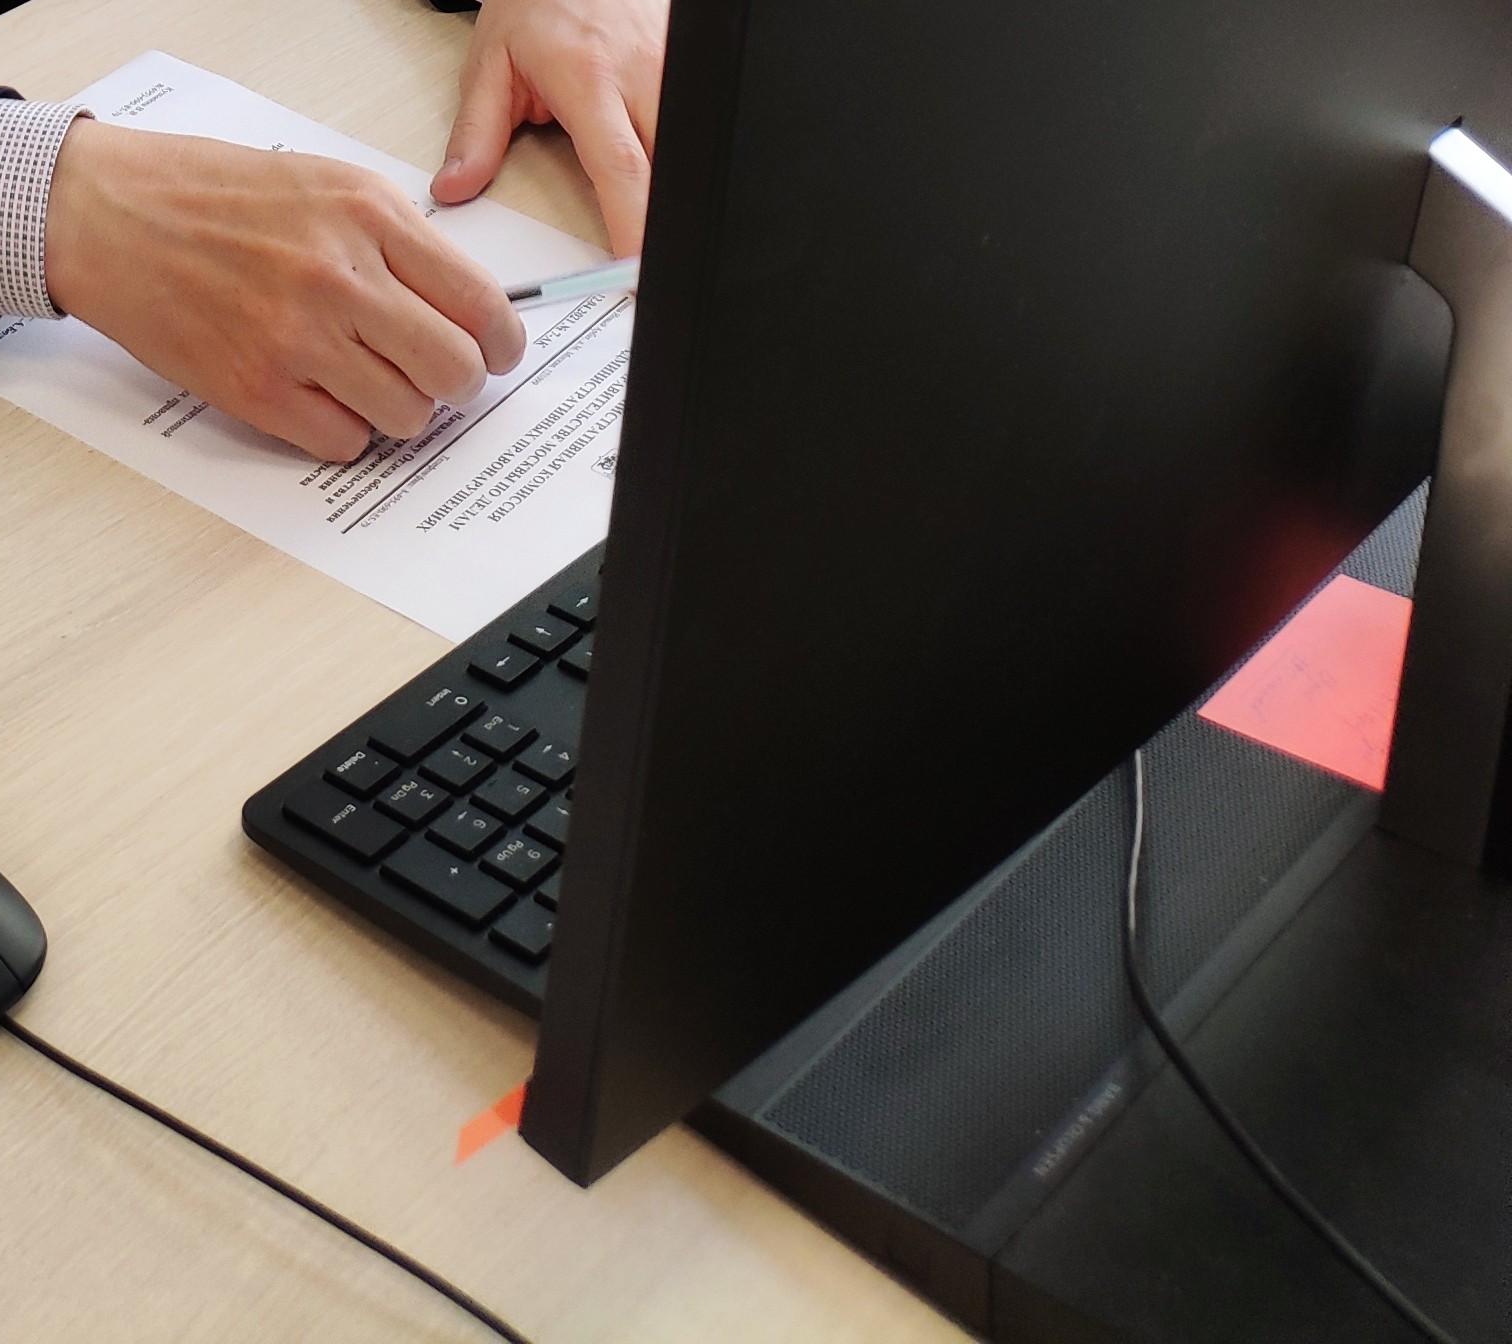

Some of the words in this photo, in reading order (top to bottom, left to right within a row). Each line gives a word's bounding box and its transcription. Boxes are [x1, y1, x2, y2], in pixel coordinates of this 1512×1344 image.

[565, 290, 606, 324] 12.04.2021
[408, 411, 465, 454] Начальнику
[333, 442, 397, 497] строительства
[379, 449, 415, 479] Отдела
[504, 441, 557, 487] МОСКВЫ
[326, 478, 381, 523] обеспечения
[416, 438, 530, 533] ПРАВОНАРУШЕНИЯХ
[487, 469, 553, 522] КОМИССИЯ
[488, 481, 508, 497] ПО
[448, 494, 491, 531] ДЕЛАМ
[336, 750, 367, 773] Delete
[332, 803, 357, 825] Enter
